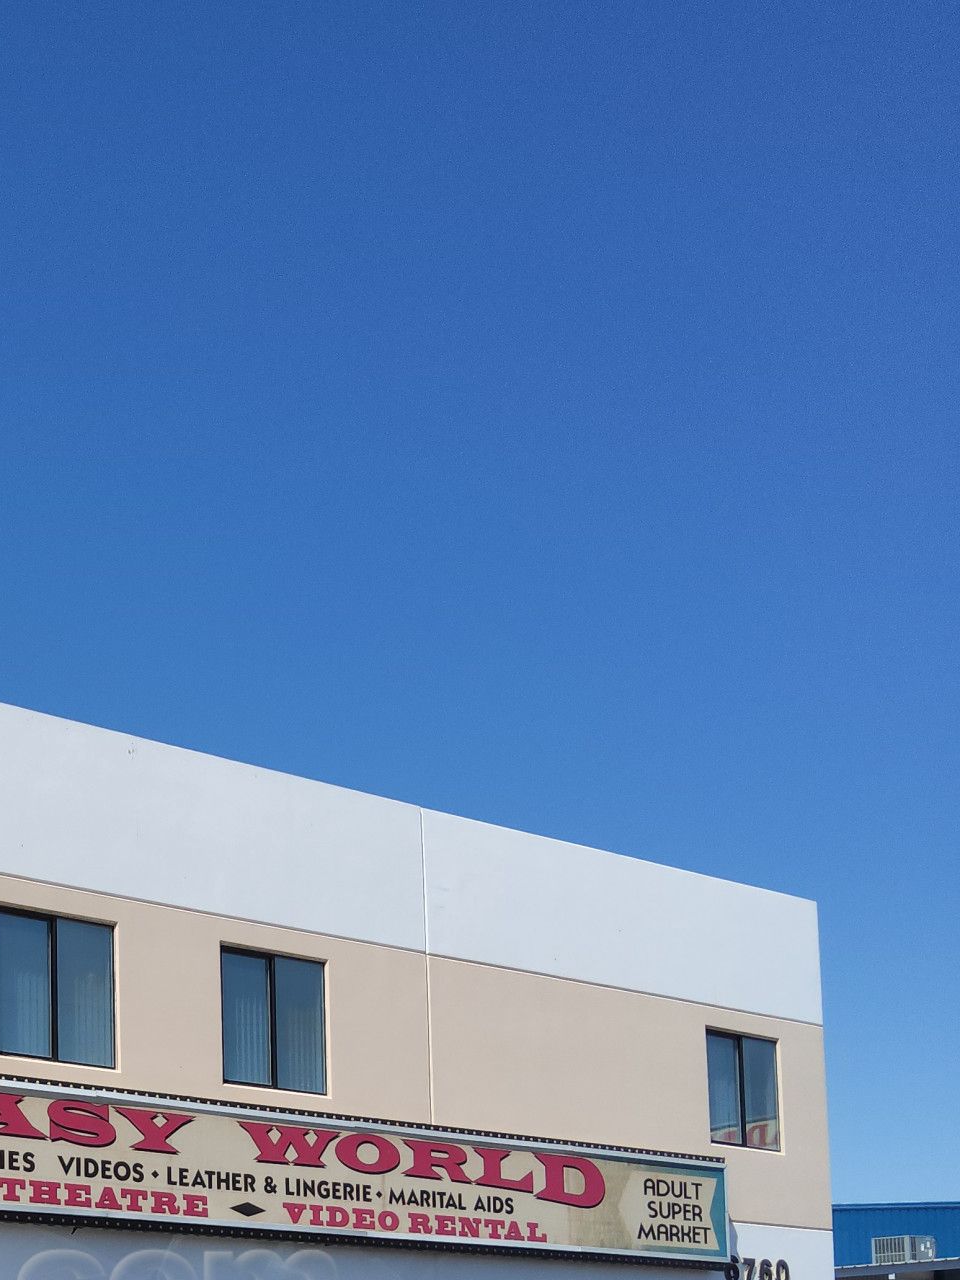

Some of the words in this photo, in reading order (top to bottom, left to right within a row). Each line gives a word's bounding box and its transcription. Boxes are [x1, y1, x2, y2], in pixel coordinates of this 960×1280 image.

[239, 1121, 606, 1209] WORLD
[57, 1155, 144, 1182] VIDEOS
[167, 1167, 256, 1193] LEATHER
[264, 1175, 278, 1195] &
[285, 1178, 371, 1203] LINGERIE
[389, 1188, 467, 1212] MARITAL
[474, 1196, 515, 1214] AIDS
[643, 1179, 703, 1201] ADULT
[282, 1202, 399, 1233] VIDEO
[408, 1211, 547, 1243] RENTAL
[648, 1200, 704, 1223] SUPER
[637, 1221, 712, 1245] MARKET
